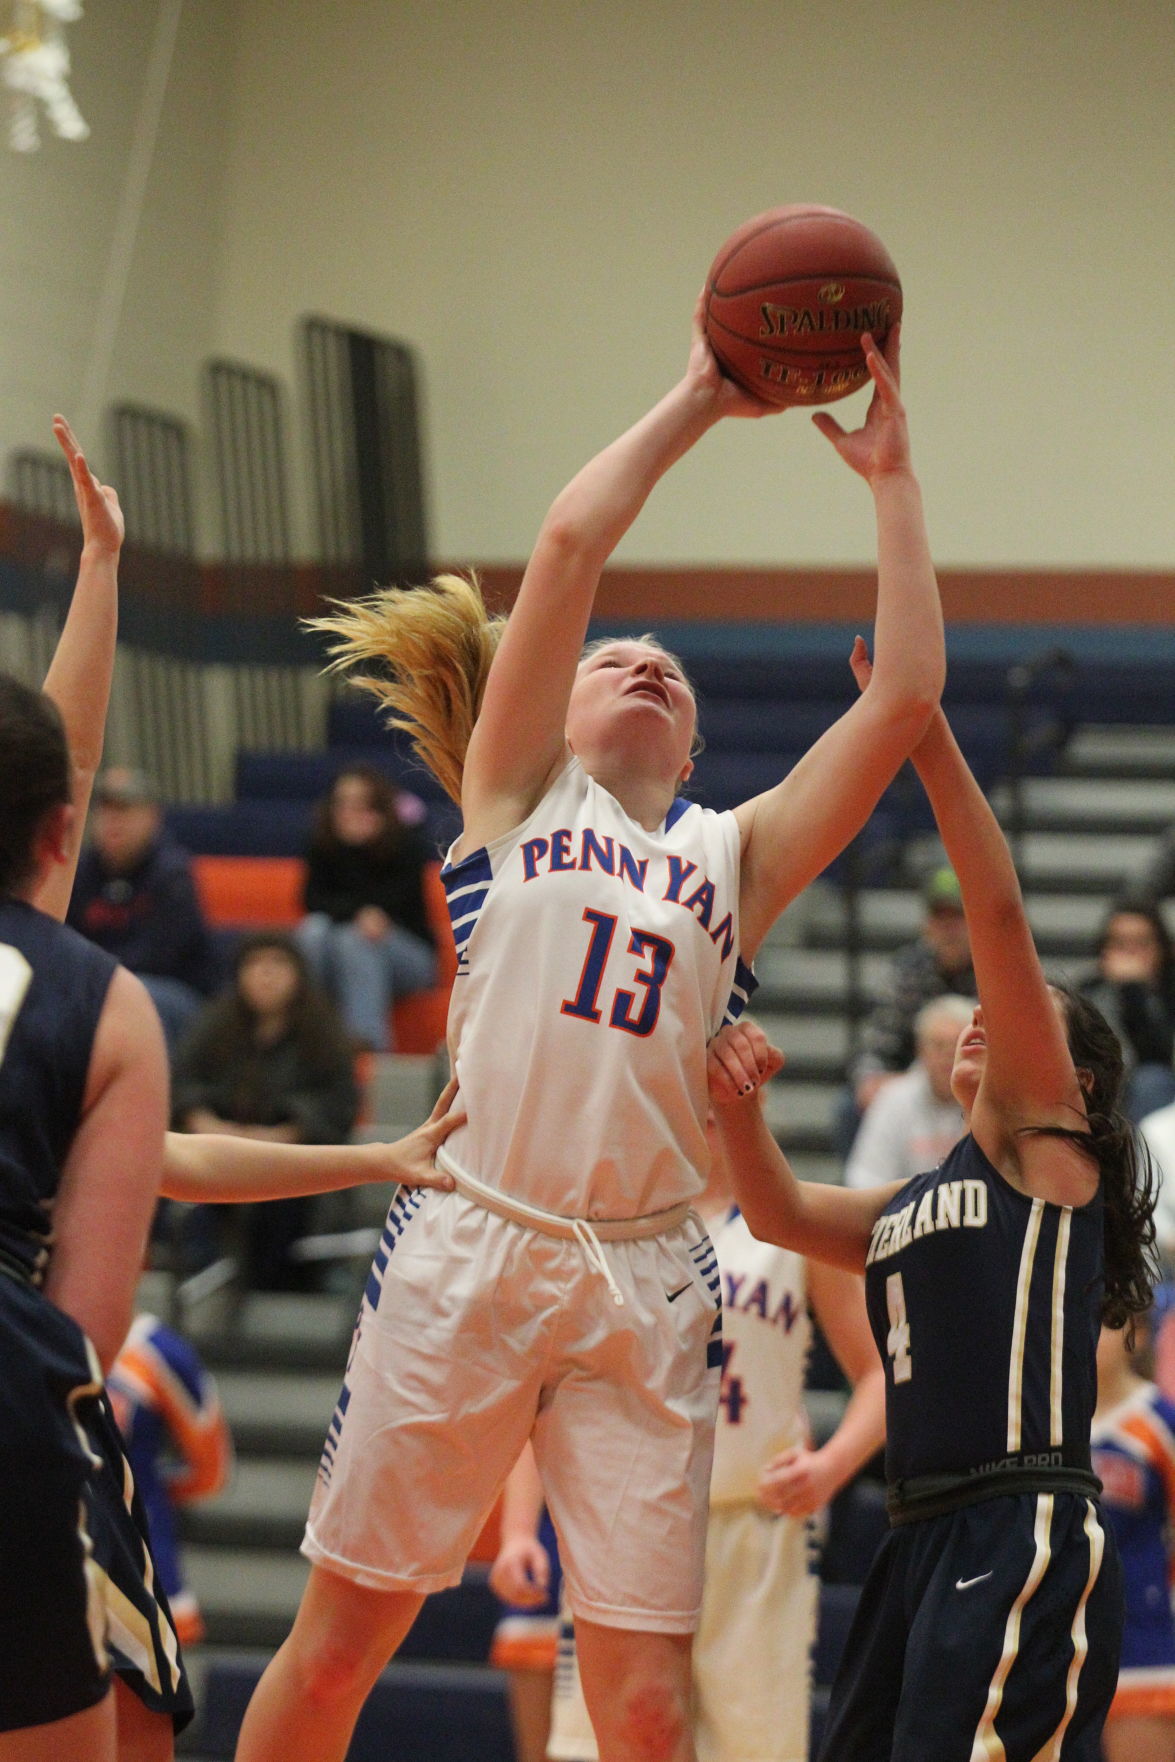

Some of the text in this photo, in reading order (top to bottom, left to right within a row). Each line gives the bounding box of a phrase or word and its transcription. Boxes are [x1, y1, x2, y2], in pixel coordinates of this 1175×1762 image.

[760, 298, 891, 336] SPALDING
[519, 828, 735, 964] PENN YAN
[560, 906, 676, 1038] 13
[723, 1272, 799, 1335] YAN
[885, 1271, 913, 1385] 4
